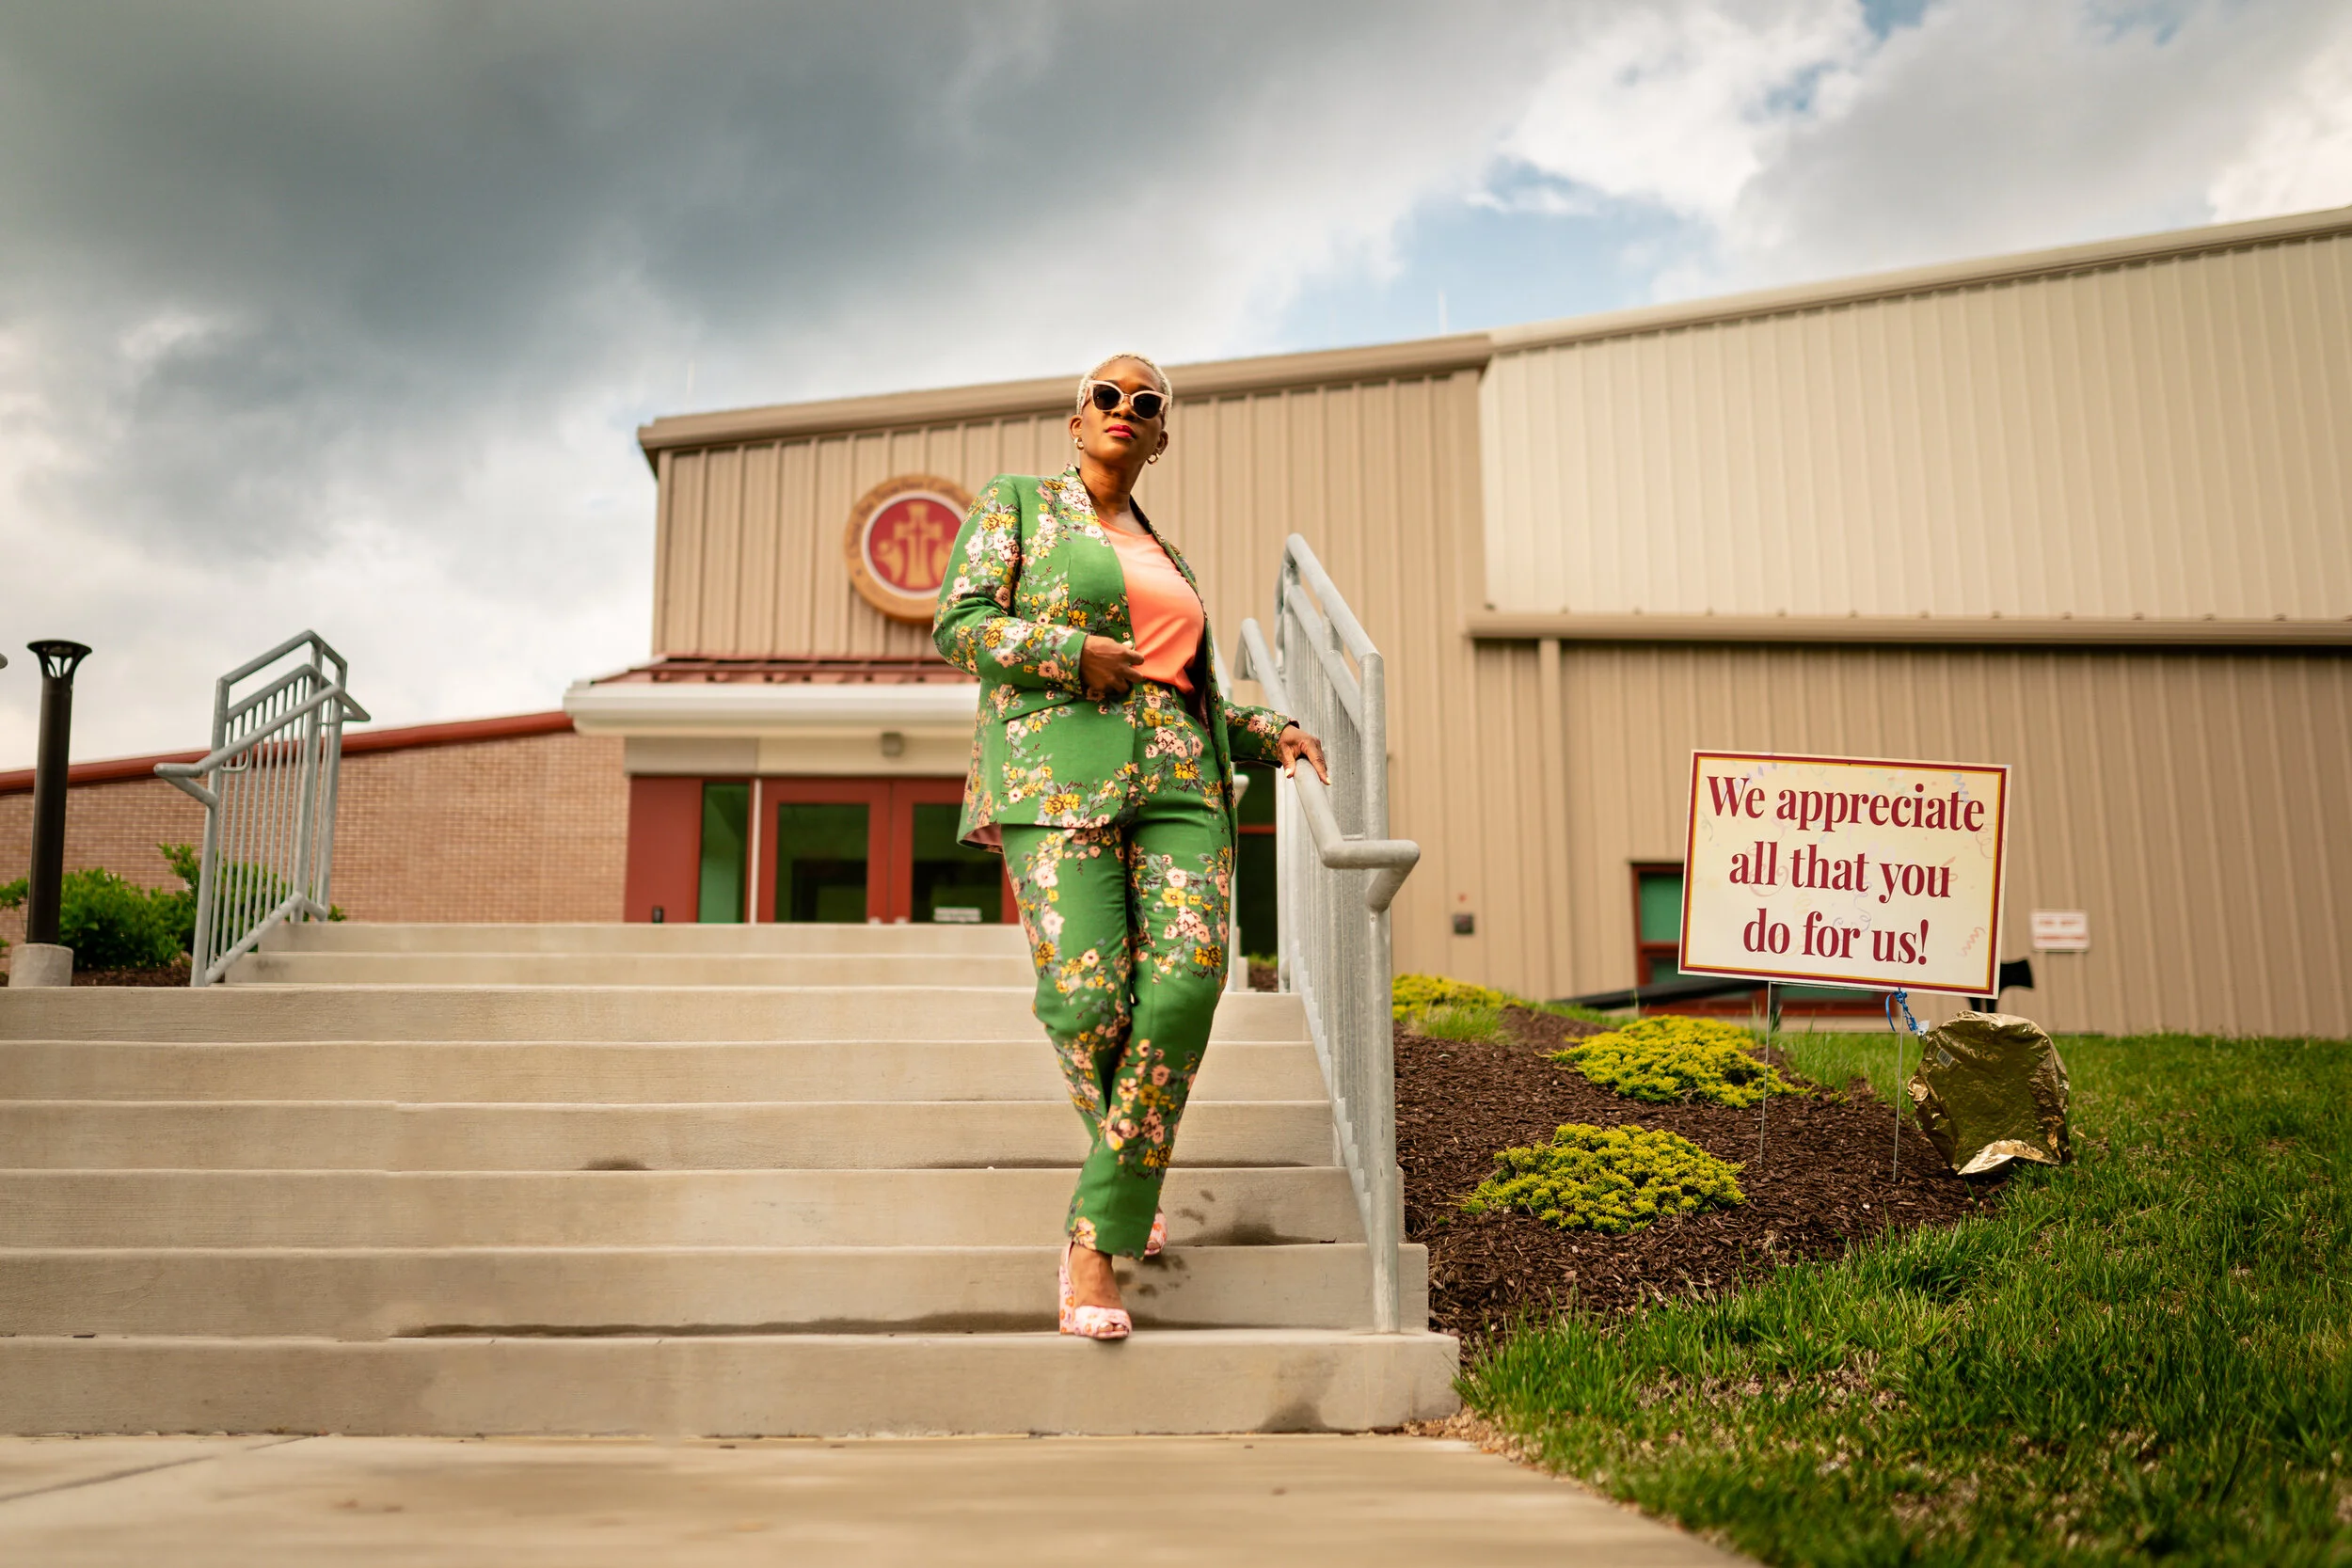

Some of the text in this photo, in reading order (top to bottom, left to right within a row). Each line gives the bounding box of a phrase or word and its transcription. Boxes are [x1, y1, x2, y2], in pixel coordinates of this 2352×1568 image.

[1707, 776, 1984, 832] We appreciate
[1729, 841, 1950, 904] all that you
[1743, 908, 1930, 965] do for us!
